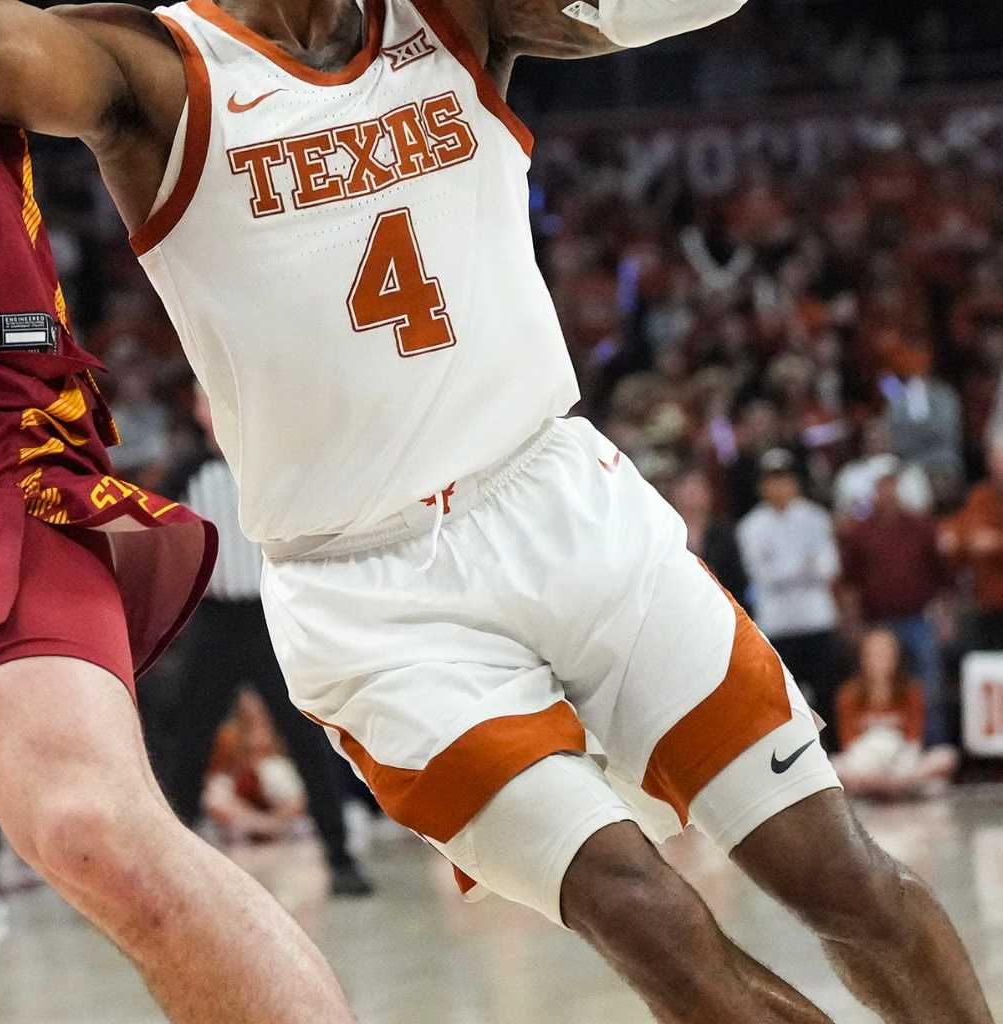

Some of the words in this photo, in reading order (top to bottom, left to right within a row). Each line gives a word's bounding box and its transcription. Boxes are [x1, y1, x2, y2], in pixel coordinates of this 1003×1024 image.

[382, 27, 437, 72] XII
[227, 90, 479, 218] TEXAS
[346, 207, 457, 357] 4
